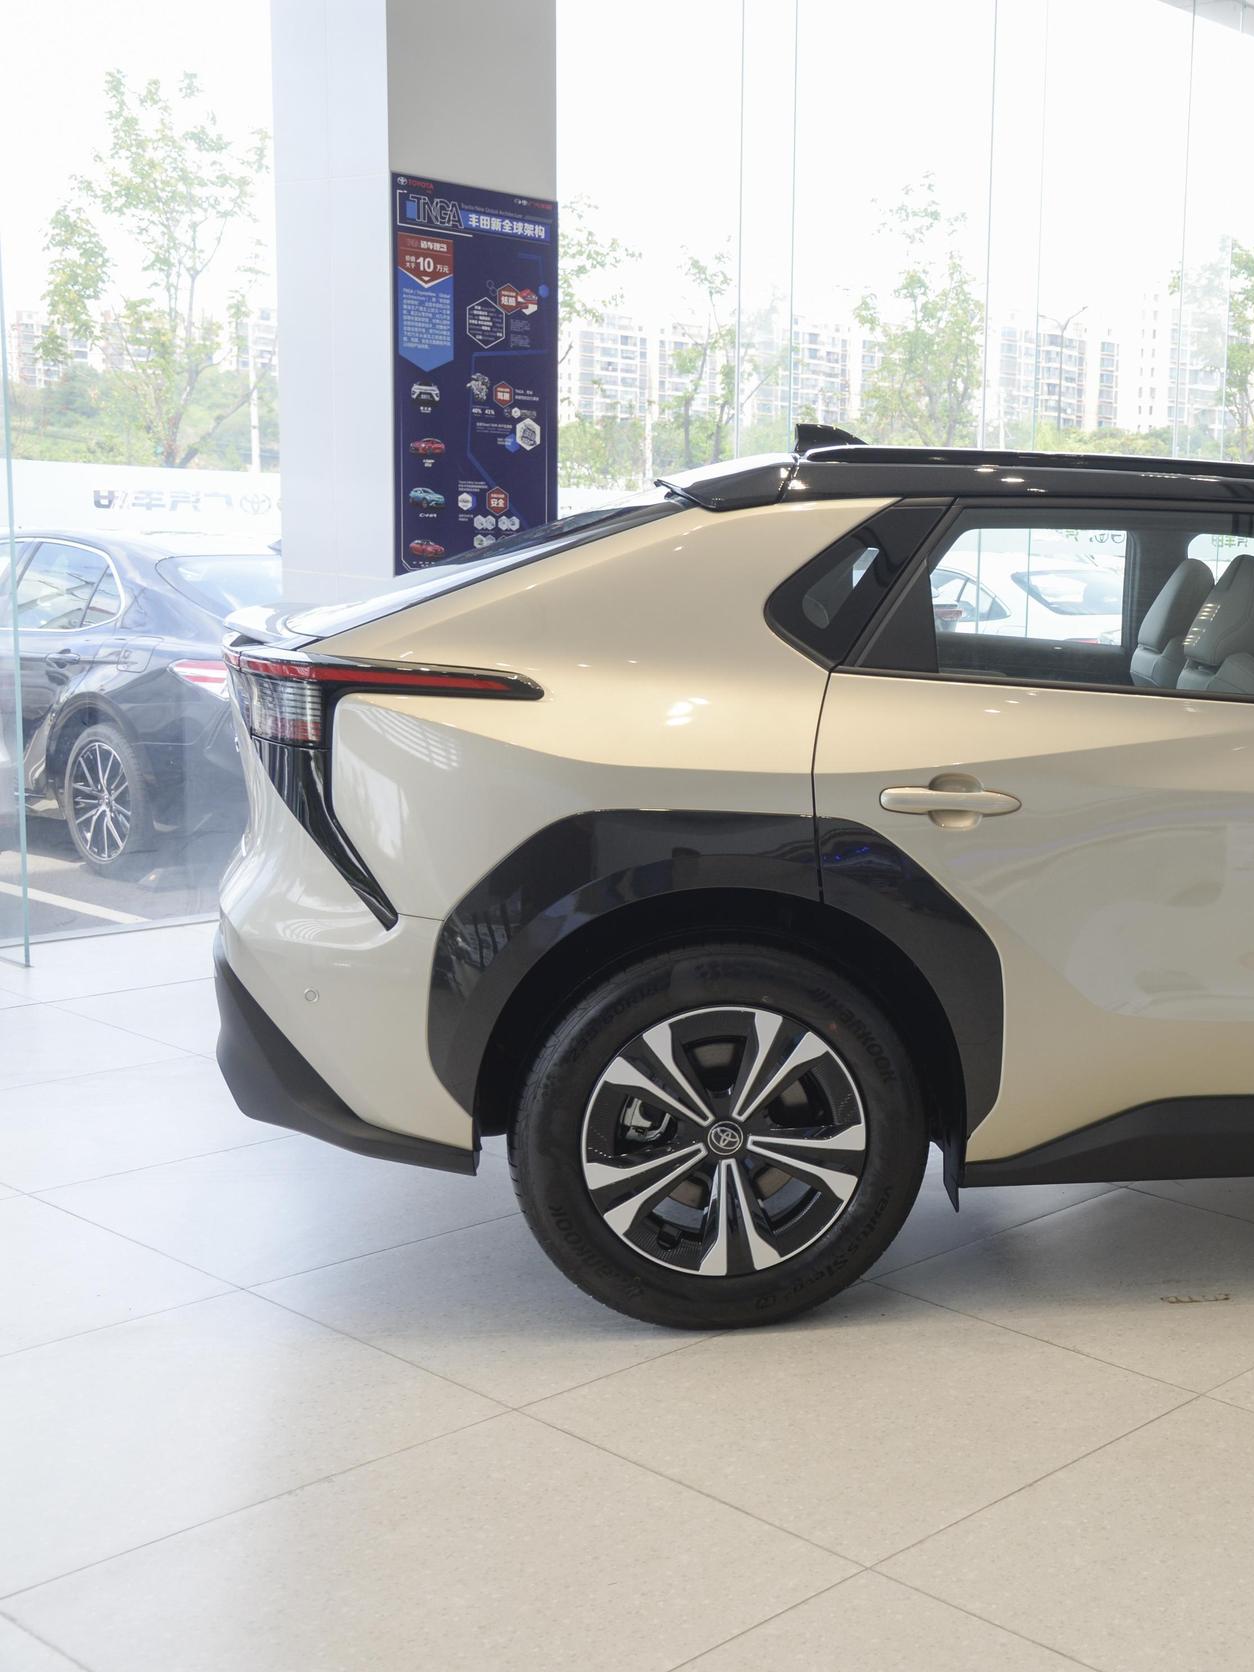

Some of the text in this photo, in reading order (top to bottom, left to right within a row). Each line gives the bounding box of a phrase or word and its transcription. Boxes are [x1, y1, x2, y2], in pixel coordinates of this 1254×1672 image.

[409, 194, 464, 229] TNGA
[468, 213, 545, 239] 丰田新全球架构
[416, 256, 434, 273] 10
